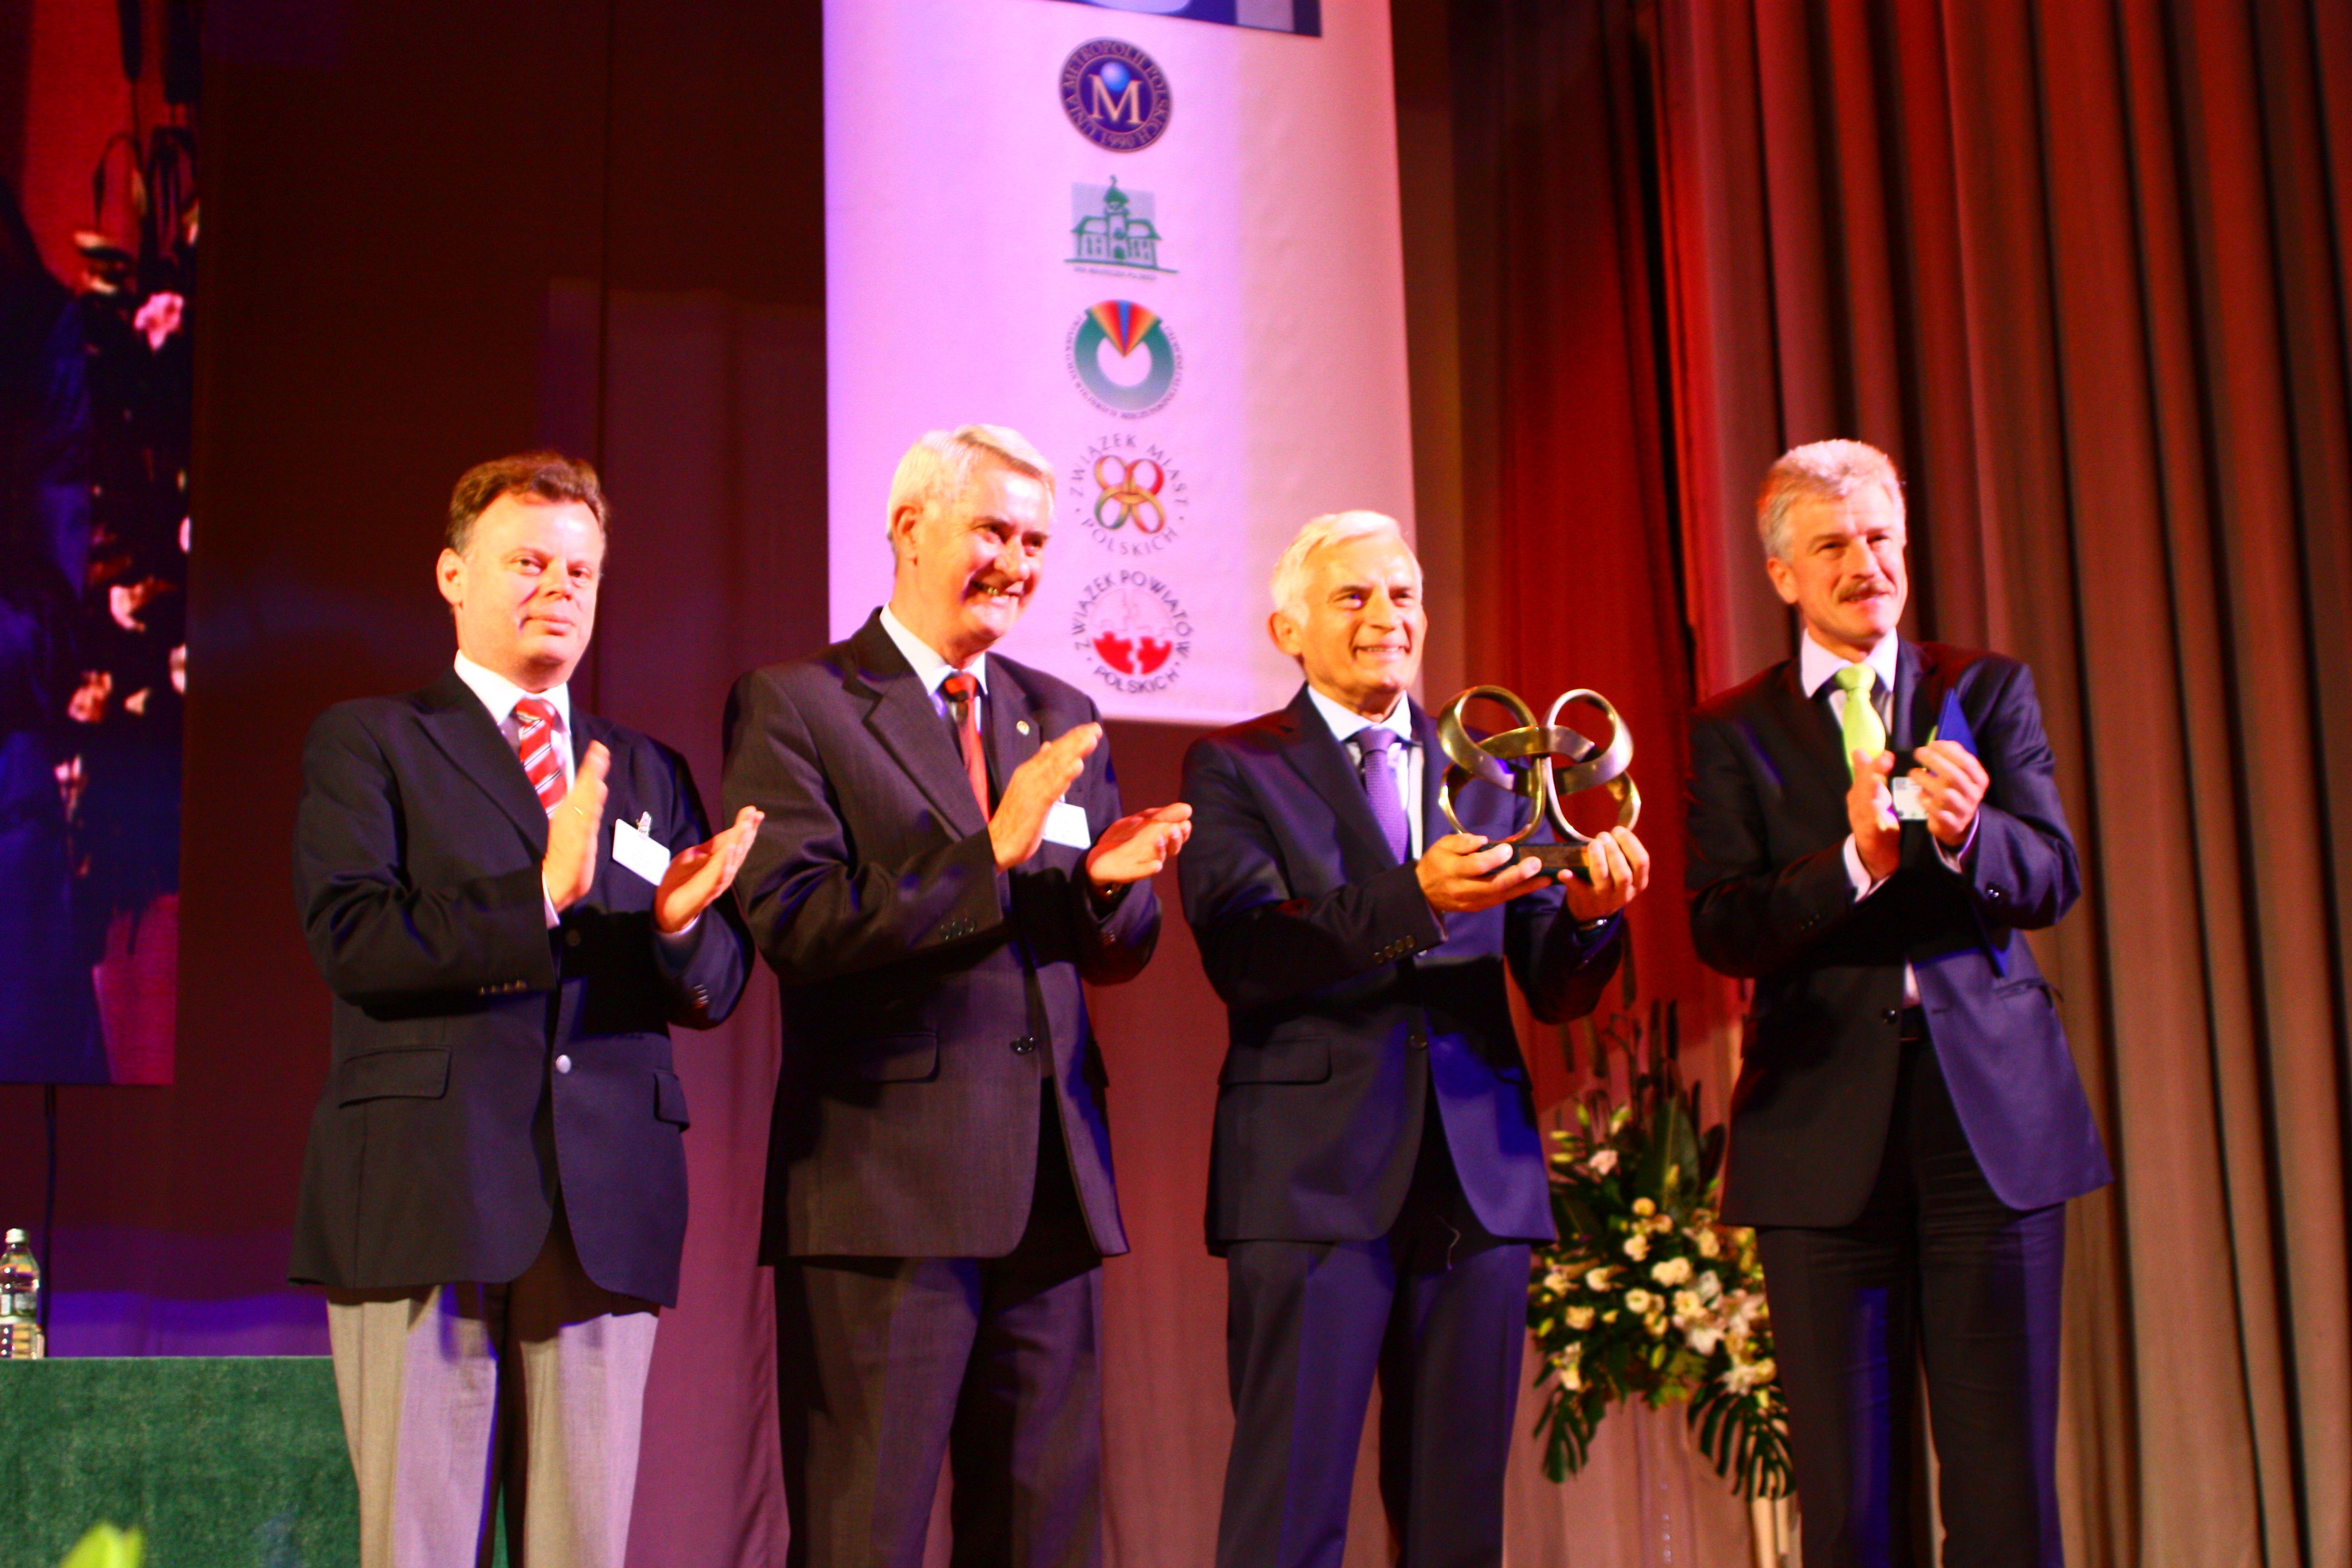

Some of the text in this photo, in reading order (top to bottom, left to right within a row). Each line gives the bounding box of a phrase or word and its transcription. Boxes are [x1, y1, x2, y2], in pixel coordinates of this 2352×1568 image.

[1087, 73, 1144, 124] M
[1146, 443, 1189, 507] MIAST
[1081, 518, 1178, 556] POLSKICH
[1093, 666, 1180, 694] POLSKICH
